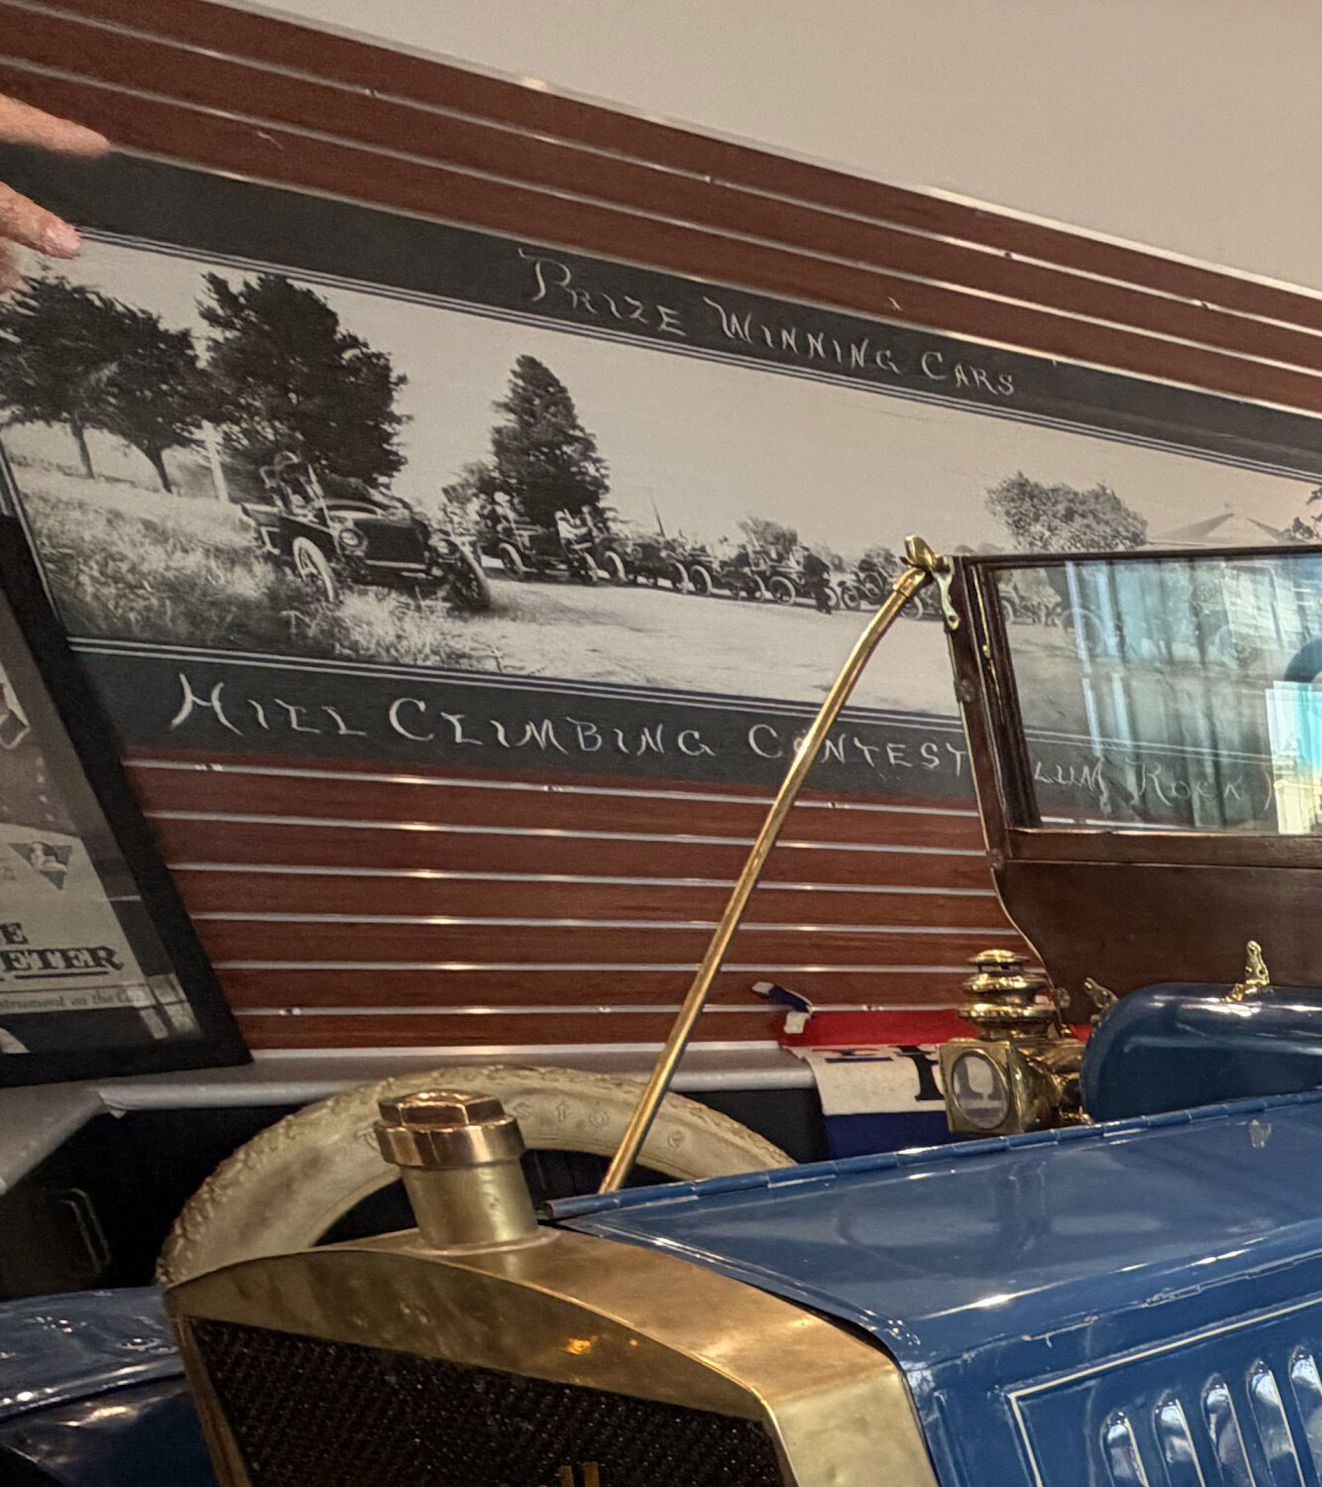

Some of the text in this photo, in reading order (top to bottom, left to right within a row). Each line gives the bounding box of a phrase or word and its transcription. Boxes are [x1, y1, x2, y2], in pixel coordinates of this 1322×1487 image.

[518, 248, 1015, 396] PRIZE WINNING CARS
[171, 672, 367, 737] HILL
[389, 698, 713, 760] CLIMBING
[1034, 758, 1107, 793] LUM
